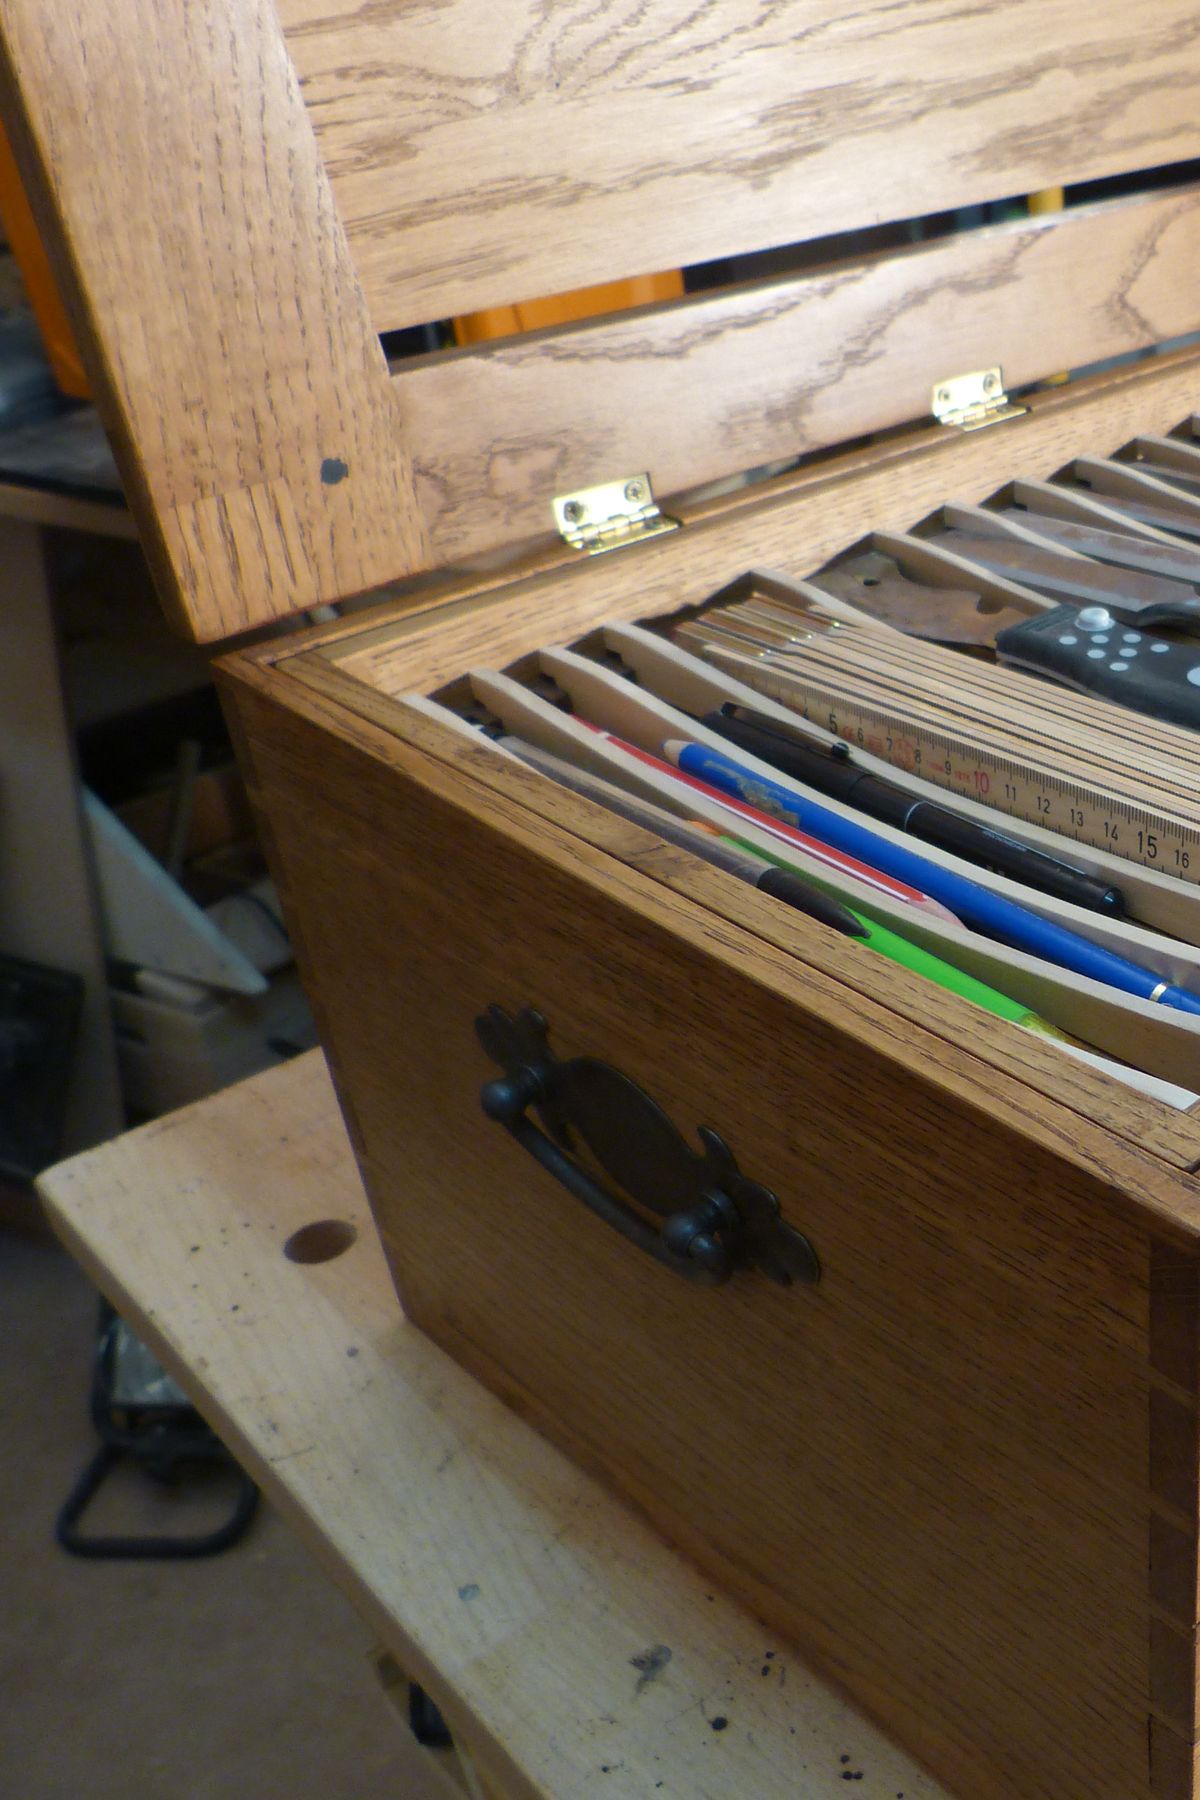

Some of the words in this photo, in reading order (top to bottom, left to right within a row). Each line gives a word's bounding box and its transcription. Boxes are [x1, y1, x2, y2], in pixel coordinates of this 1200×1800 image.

[829, 713, 838, 734] 5
[857, 727, 864, 742] 6
[886, 735, 893, 751] 7
[914, 748, 921, 764] 8
[944, 760, 951, 775] 9
[974, 770, 990, 794] 10
[1005, 784, 1017, 802] 11
[1037, 796, 1051, 814] 12
[1070, 808, 1084, 827] 13
[1104, 821, 1118, 841] 14
[1137, 831, 1158, 858] 15
[1175, 849, 1190, 868] 16
